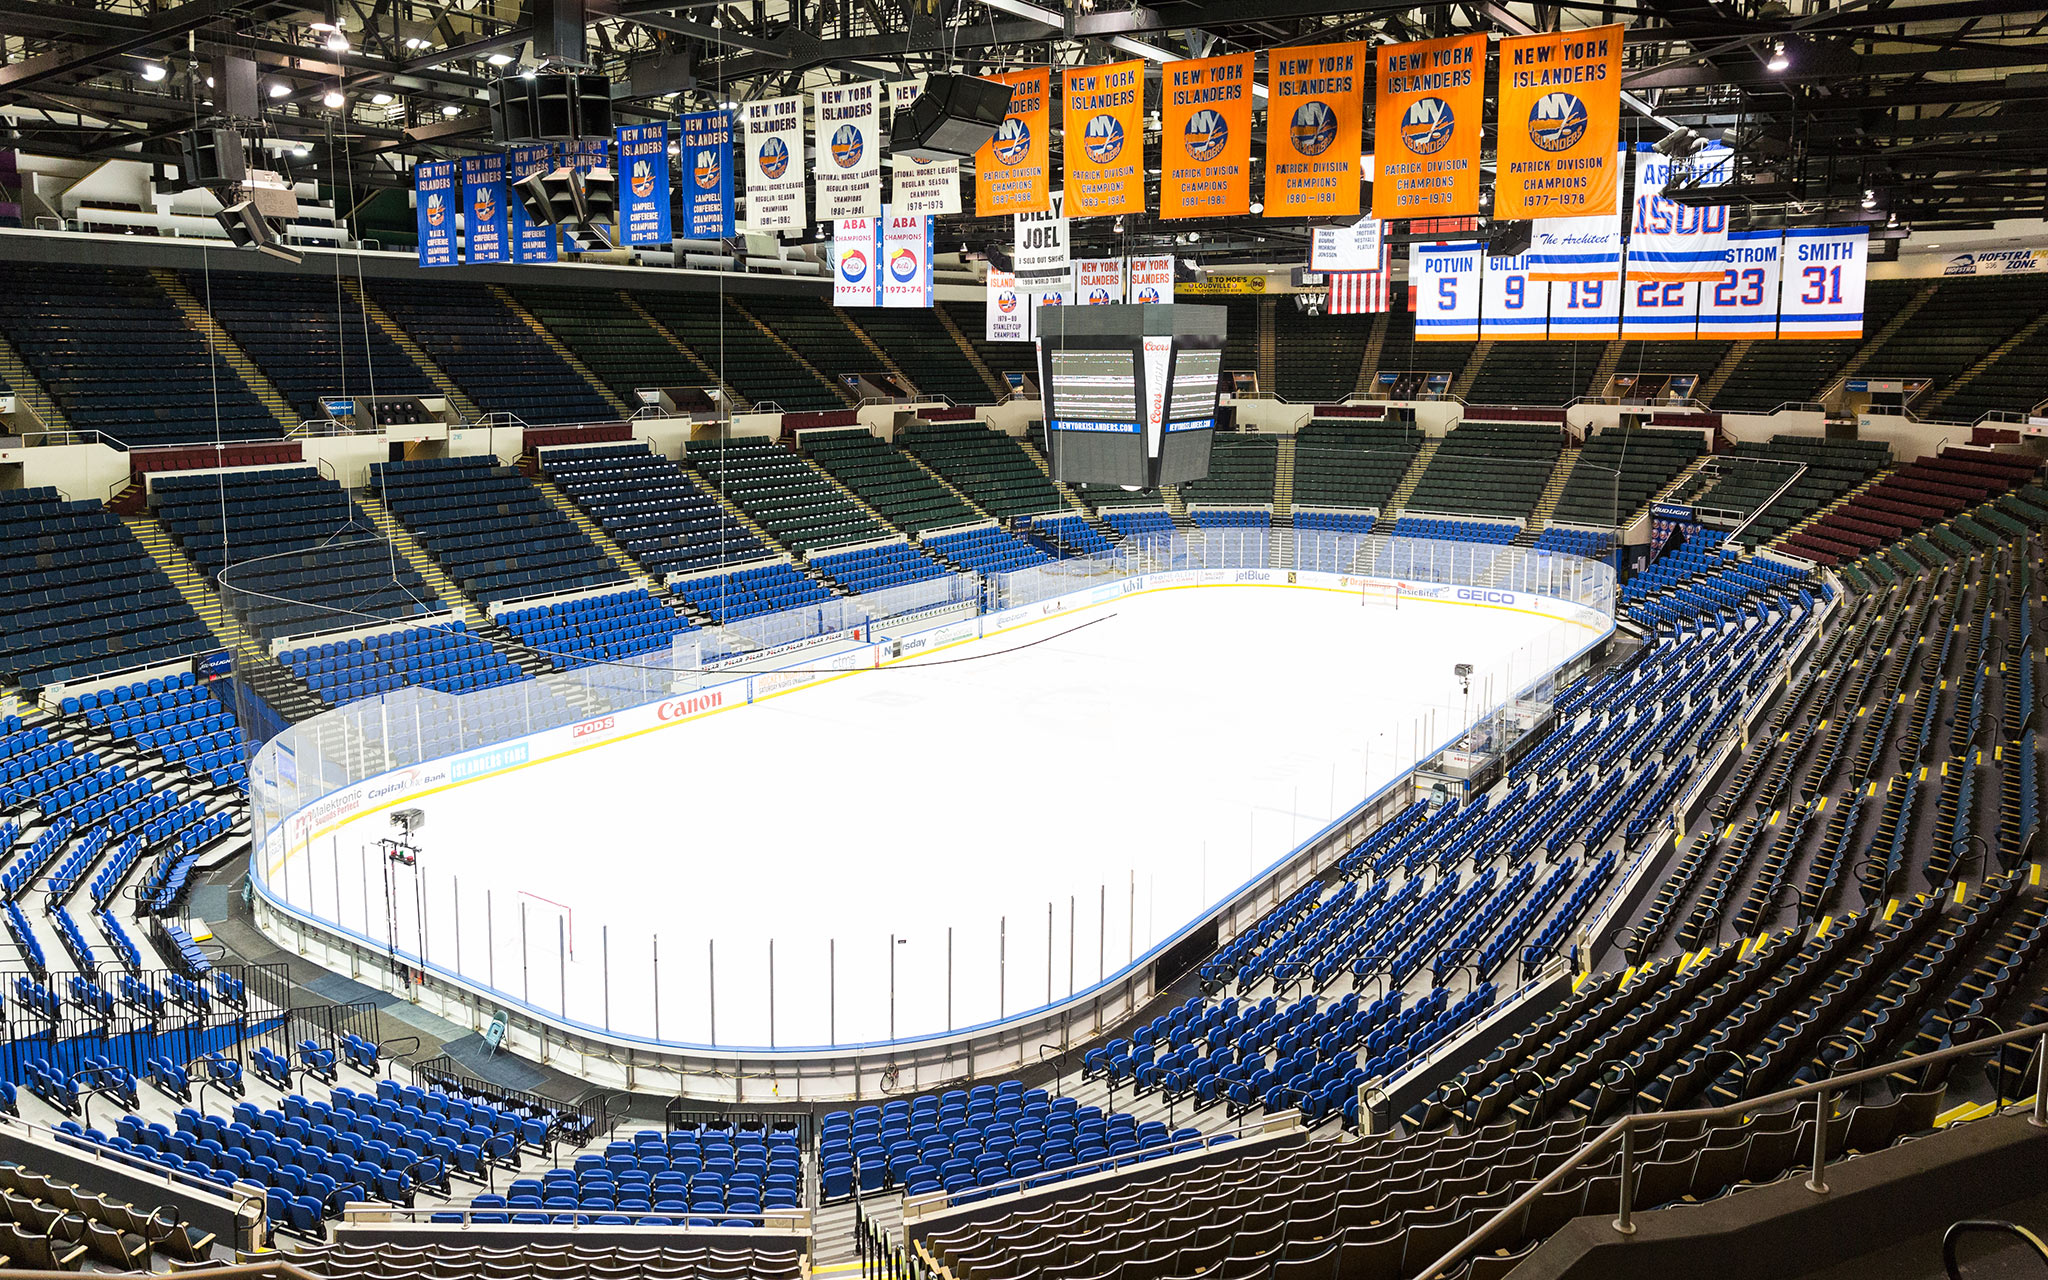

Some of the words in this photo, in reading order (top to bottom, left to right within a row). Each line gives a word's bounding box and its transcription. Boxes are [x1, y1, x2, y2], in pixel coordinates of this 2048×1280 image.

[1389, 54, 1422, 72] NEW
[1434, 46, 1473, 67] YORK
[1514, 46, 1551, 65] NEW
[1564, 40, 1608, 60] YORK
[1280, 60, 1308, 76] NEW
[1319, 56, 1354, 72] YORK
[1071, 77, 1096, 92] NEW
[1105, 70, 1134, 88] YORK
[1174, 70, 1201, 86] NEW
[1210, 64, 1243, 82] YORK
[1388, 70, 1471, 93] ISLANDERS
[1513, 64, 1606, 88] ISLANDERS
[896, 86, 918, 100] NEW
[1013, 80, 1040, 96] YORK
[1279, 77, 1353, 96] ISLANDERS
[822, 90, 841, 104] NEW
[848, 85, 872, 100] YORK
[1072, 90, 1134, 110] ISLANDERS
[1174, 84, 1242, 106] ISLANDERS
[750, 105, 769, 118] NEW
[774, 101, 796, 114] YORK
[822, 103, 872, 120] ISLANDERS
[686, 119, 702, 131] NEW
[708, 116, 728, 129] YORK
[751, 118, 796, 134] ISLANDERS
[622, 129, 638, 141] NEW
[643, 126, 662, 139] YORK
[686, 132, 728, 146] ISLANDERS
[1530, 126, 1582, 151] ISLANDERS
[622, 142, 662, 156] ISLANDERS
[1402, 129, 1450, 154] ISLANDERS
[419, 167, 432, 178] NEW
[466, 160, 480, 172] NEW
[484, 158, 501, 169] YORK
[917, 168, 936, 176] HOCKEY
[938, 166, 958, 174] LEAGUE
[1172, 168, 1202, 179] PATRICK
[1206, 166, 1238, 176] DIVISION
[1276, 164, 1308, 174] PATRICK
[1313, 162, 1348, 172] DIVISION
[1385, 163, 1422, 174] PATRICK
[1428, 159, 1468, 172] DIVISION
[1510, 161, 1550, 173] PATRICK
[1556, 157, 1602, 170] DIVISION
[466, 171, 501, 184] ISLANDERS
[984, 170, 1010, 181] PATRICK
[1012, 167, 1042, 178] DIVISION
[1073, 169, 1100, 180] PATRICK
[1104, 166, 1134, 178] DIVISION
[420, 178, 450, 191] ISLANDERS
[992, 180, 1032, 192] CHAMPIONS
[1082, 182, 1124, 193] CHAMPIONS
[1181, 181, 1228, 192] CHAMPIONS
[1286, 178, 1336, 188] CHAMPIONS
[1397, 176, 1454, 190] CHAMPIONS
[1524, 177, 1587, 190] CHAMPIONS
[910, 190, 940, 198] CHAMPIONS
[1397, 193, 1452, 205] 1978-1979
[1524, 194, 1584, 206] 1977-1978
[843, 219, 866, 229] ABA
[893, 217, 916, 228] ABA
[1023, 226, 1060, 249] JOEL
[1726, 246, 1776, 264] STROM
[1798, 242, 1854, 260] SMITH
[1978, 250, 2032, 262] HOFSTRA
[1082, 262, 1098, 272] NEW
[1100, 261, 1118, 272] YORK
[1132, 261, 1147, 271] NEW
[1150, 260, 1169, 270] YORK
[1426, 258, 1472, 272] POTVIN
[2006, 260, 2038, 269] ZONE
[1080, 274, 1119, 286] ISLANDERS
[1132, 273, 1170, 284] SLANDERS
[1801, 266, 1843, 304] 31
[1438, 278, 1457, 310] 5
[1504, 275, 1524, 310] 9
[1568, 280, 1603, 308] 19
[1636, 282, 1684, 307] 22
[1714, 268, 1765, 307] 23
[1145, 341, 1168, 352] Coors
[1150, 393, 1162, 424] Coors
[1058, 421, 1133, 432] NEWYORKISLANDERS.COM
[1670, 508, 1690, 516] LIGHT
[1236, 570, 1270, 582] jetBlue
[1122, 578, 1142, 594] Advil
[1398, 588, 1438, 598] BasicBites
[1457, 588, 1514, 604] GEICO
[658, 692, 722, 720] Canon
[574, 718, 614, 738] PODS
[453, 753, 500, 778] ISLANDERS
[504, 747, 526, 764] FANS
[424, 772, 446, 784] Bank
[312, 788, 362, 818] Malektronic
[316, 810, 336, 826] Sounds
[337, 800, 360, 816] Perfect
